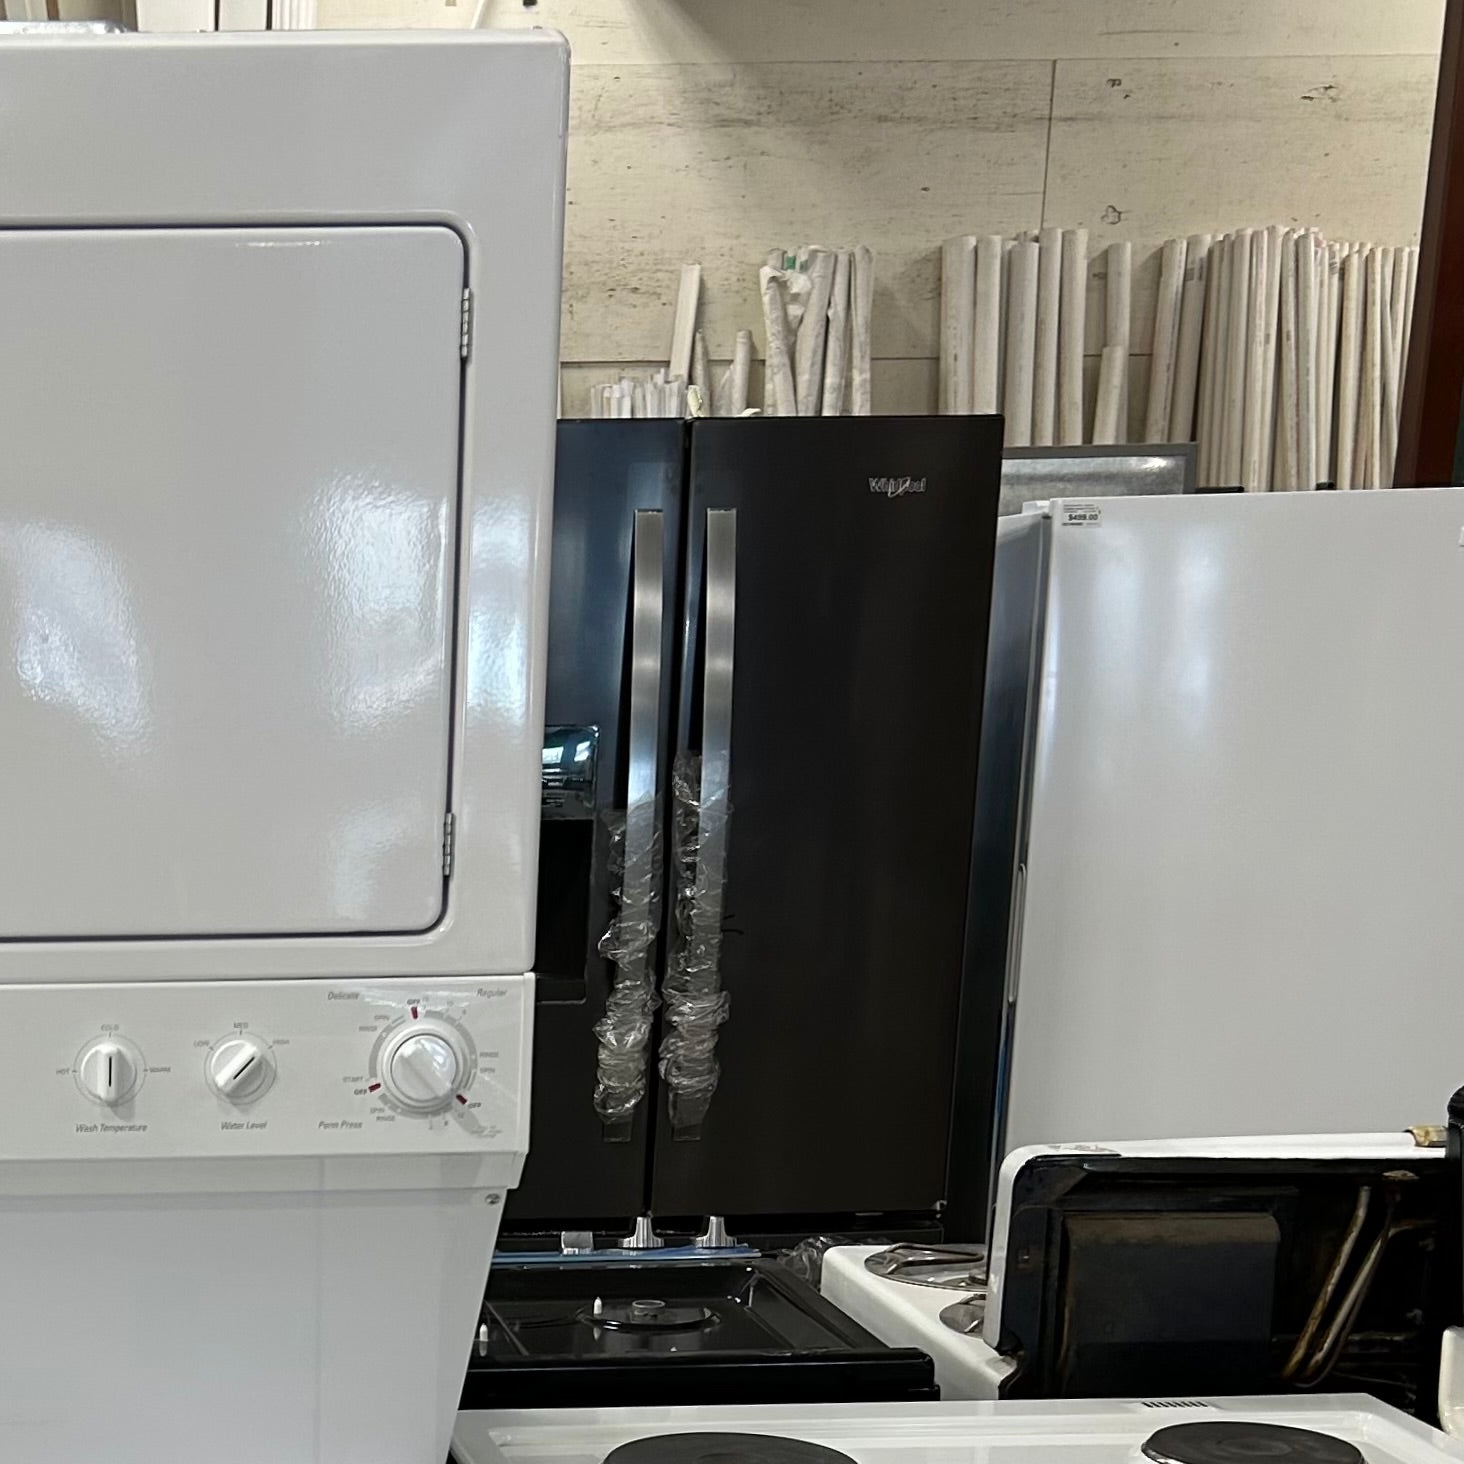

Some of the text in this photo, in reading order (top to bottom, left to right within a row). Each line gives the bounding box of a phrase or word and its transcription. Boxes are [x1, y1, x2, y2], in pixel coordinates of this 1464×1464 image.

[868, 476, 926, 498] Whirlpool
[326, 992, 360, 1001] Delicate
[477, 988, 508, 999] Regular
[74, 1123, 148, 1134] Wash Temperature
[220, 1120, 268, 1131] Water Level
[318, 1120, 363, 1129] Perm Press
